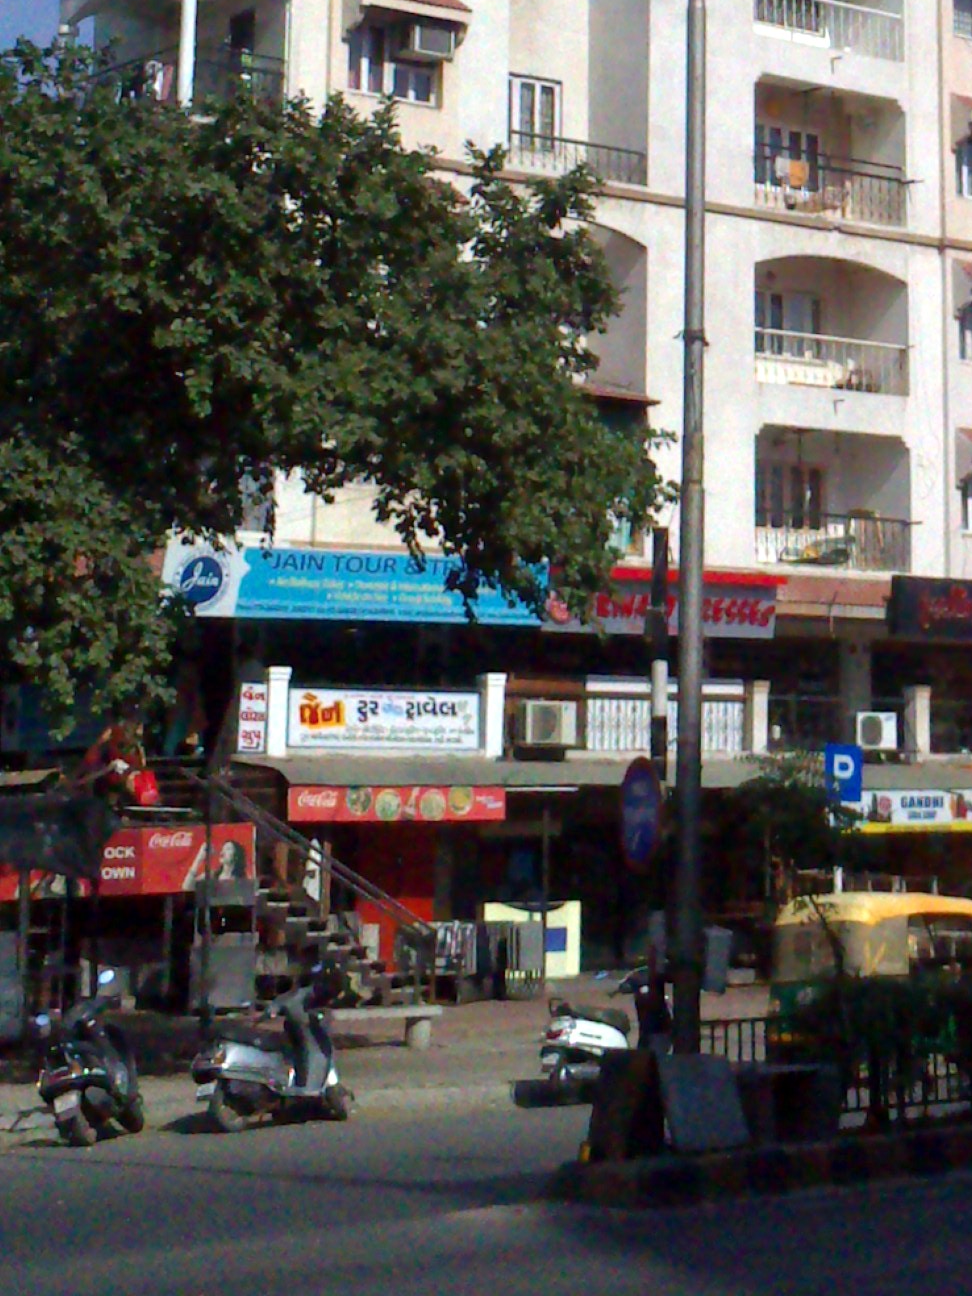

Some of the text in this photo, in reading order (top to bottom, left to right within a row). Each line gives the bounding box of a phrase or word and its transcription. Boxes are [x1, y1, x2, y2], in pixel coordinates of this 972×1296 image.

[272, 554, 324, 572] JAIN
[332, 555, 397, 574] TOUR
[182, 561, 219, 592] Jain
[901, 795, 944, 808] GANDHI
[149, 831, 193, 849] Coca-Cola
[104, 846, 136, 860] OCK
[101, 866, 136, 880] OWN
